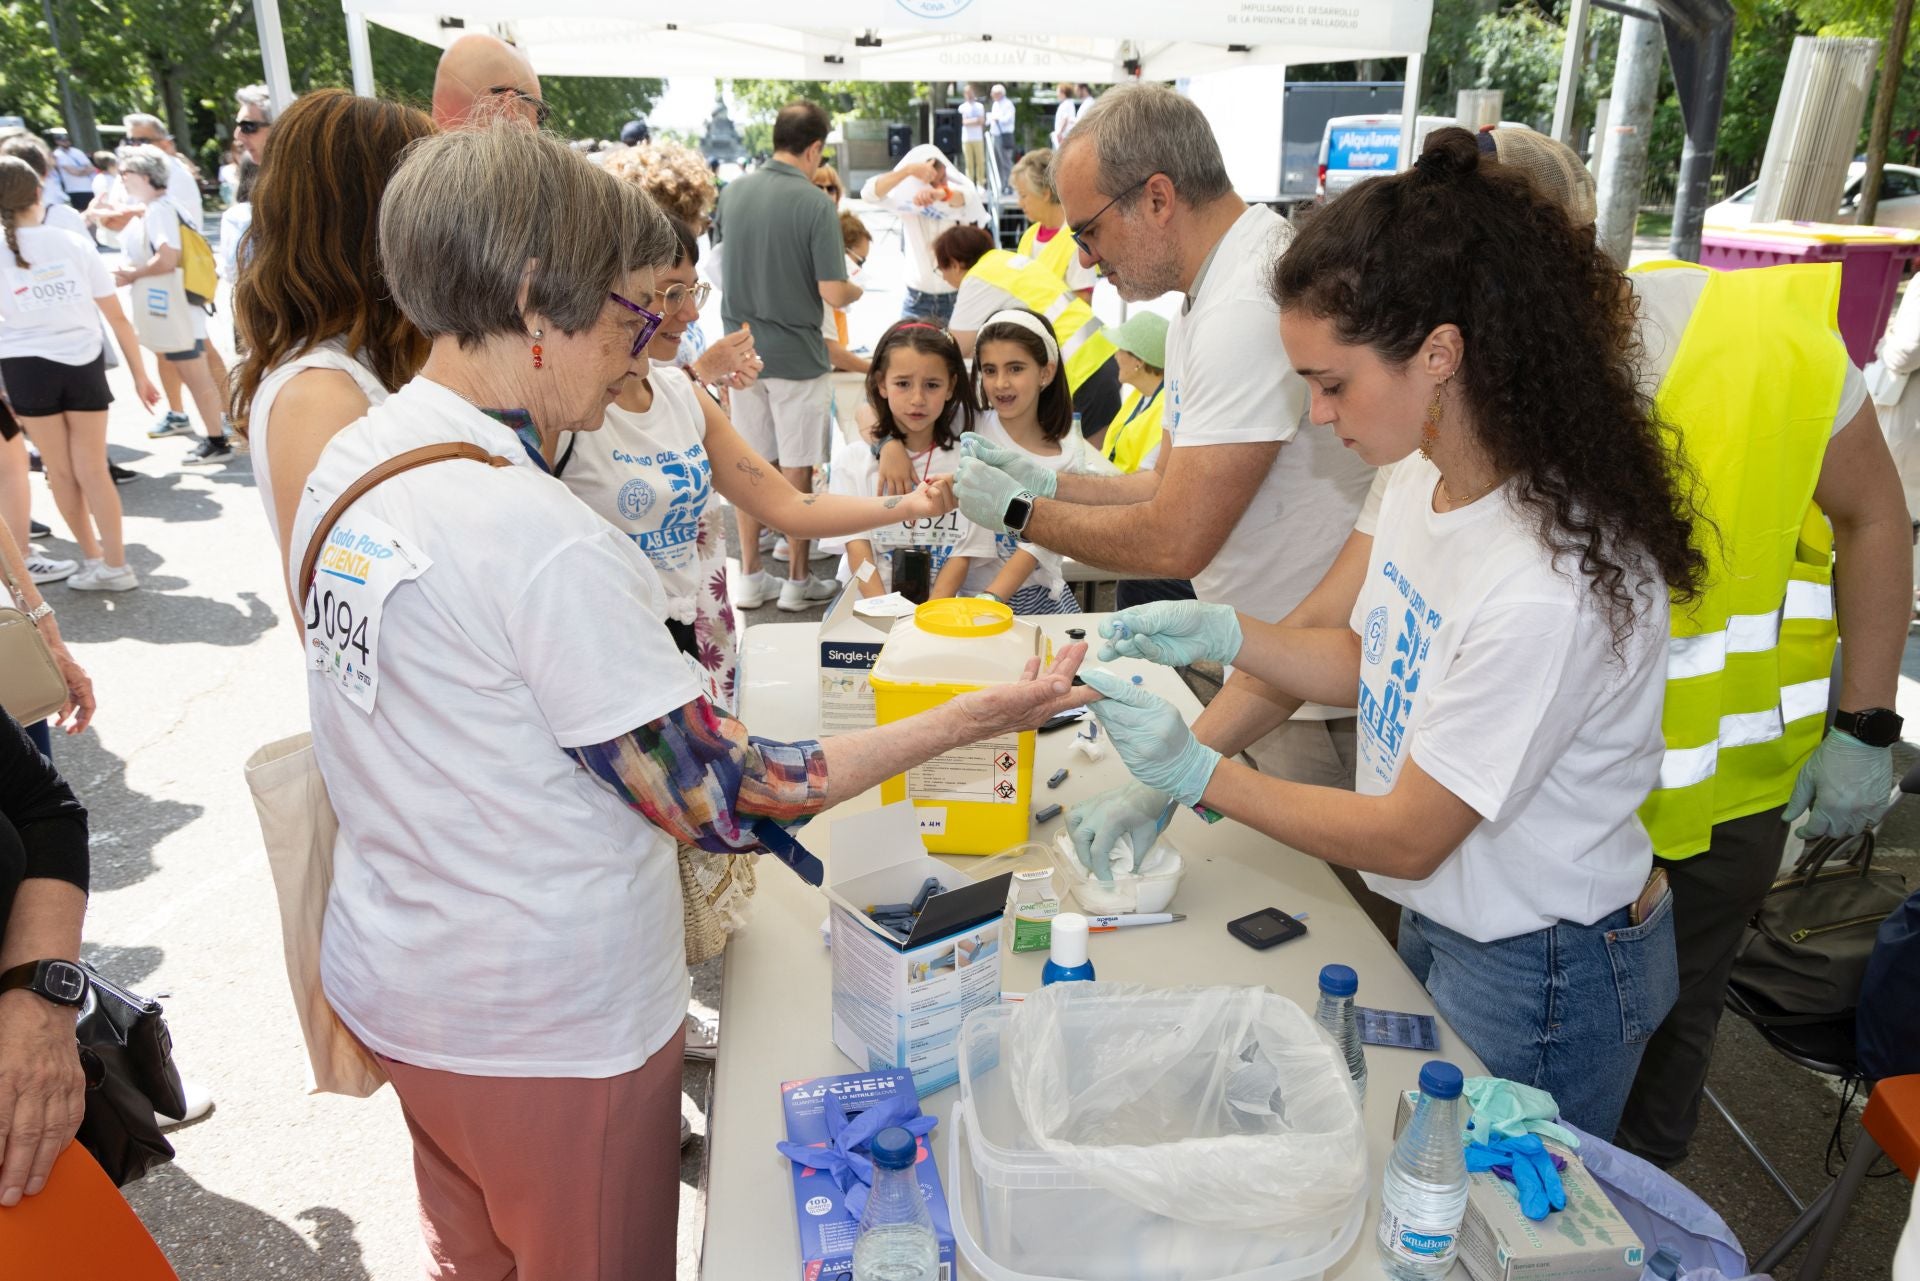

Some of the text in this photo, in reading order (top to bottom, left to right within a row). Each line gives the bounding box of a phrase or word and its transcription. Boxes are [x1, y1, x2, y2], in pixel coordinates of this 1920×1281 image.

[1240, 3, 1360, 17] IMPULSANDO EL DESARROLLO
[1227, 15, 1358, 29] DE LA PROVINCIA DE VALLADOLID
[32, 280, 76, 299] 0087
[331, 526, 394, 559] Cada Paso
[322, 545, 371, 580] CUENTA
[1020, 902, 1058, 911] ONETOUCH
[791, 1077, 895, 1100] AACHEN
[810, 1198, 828, 1206] 100
[1628, 1249, 1642, 1262] M
